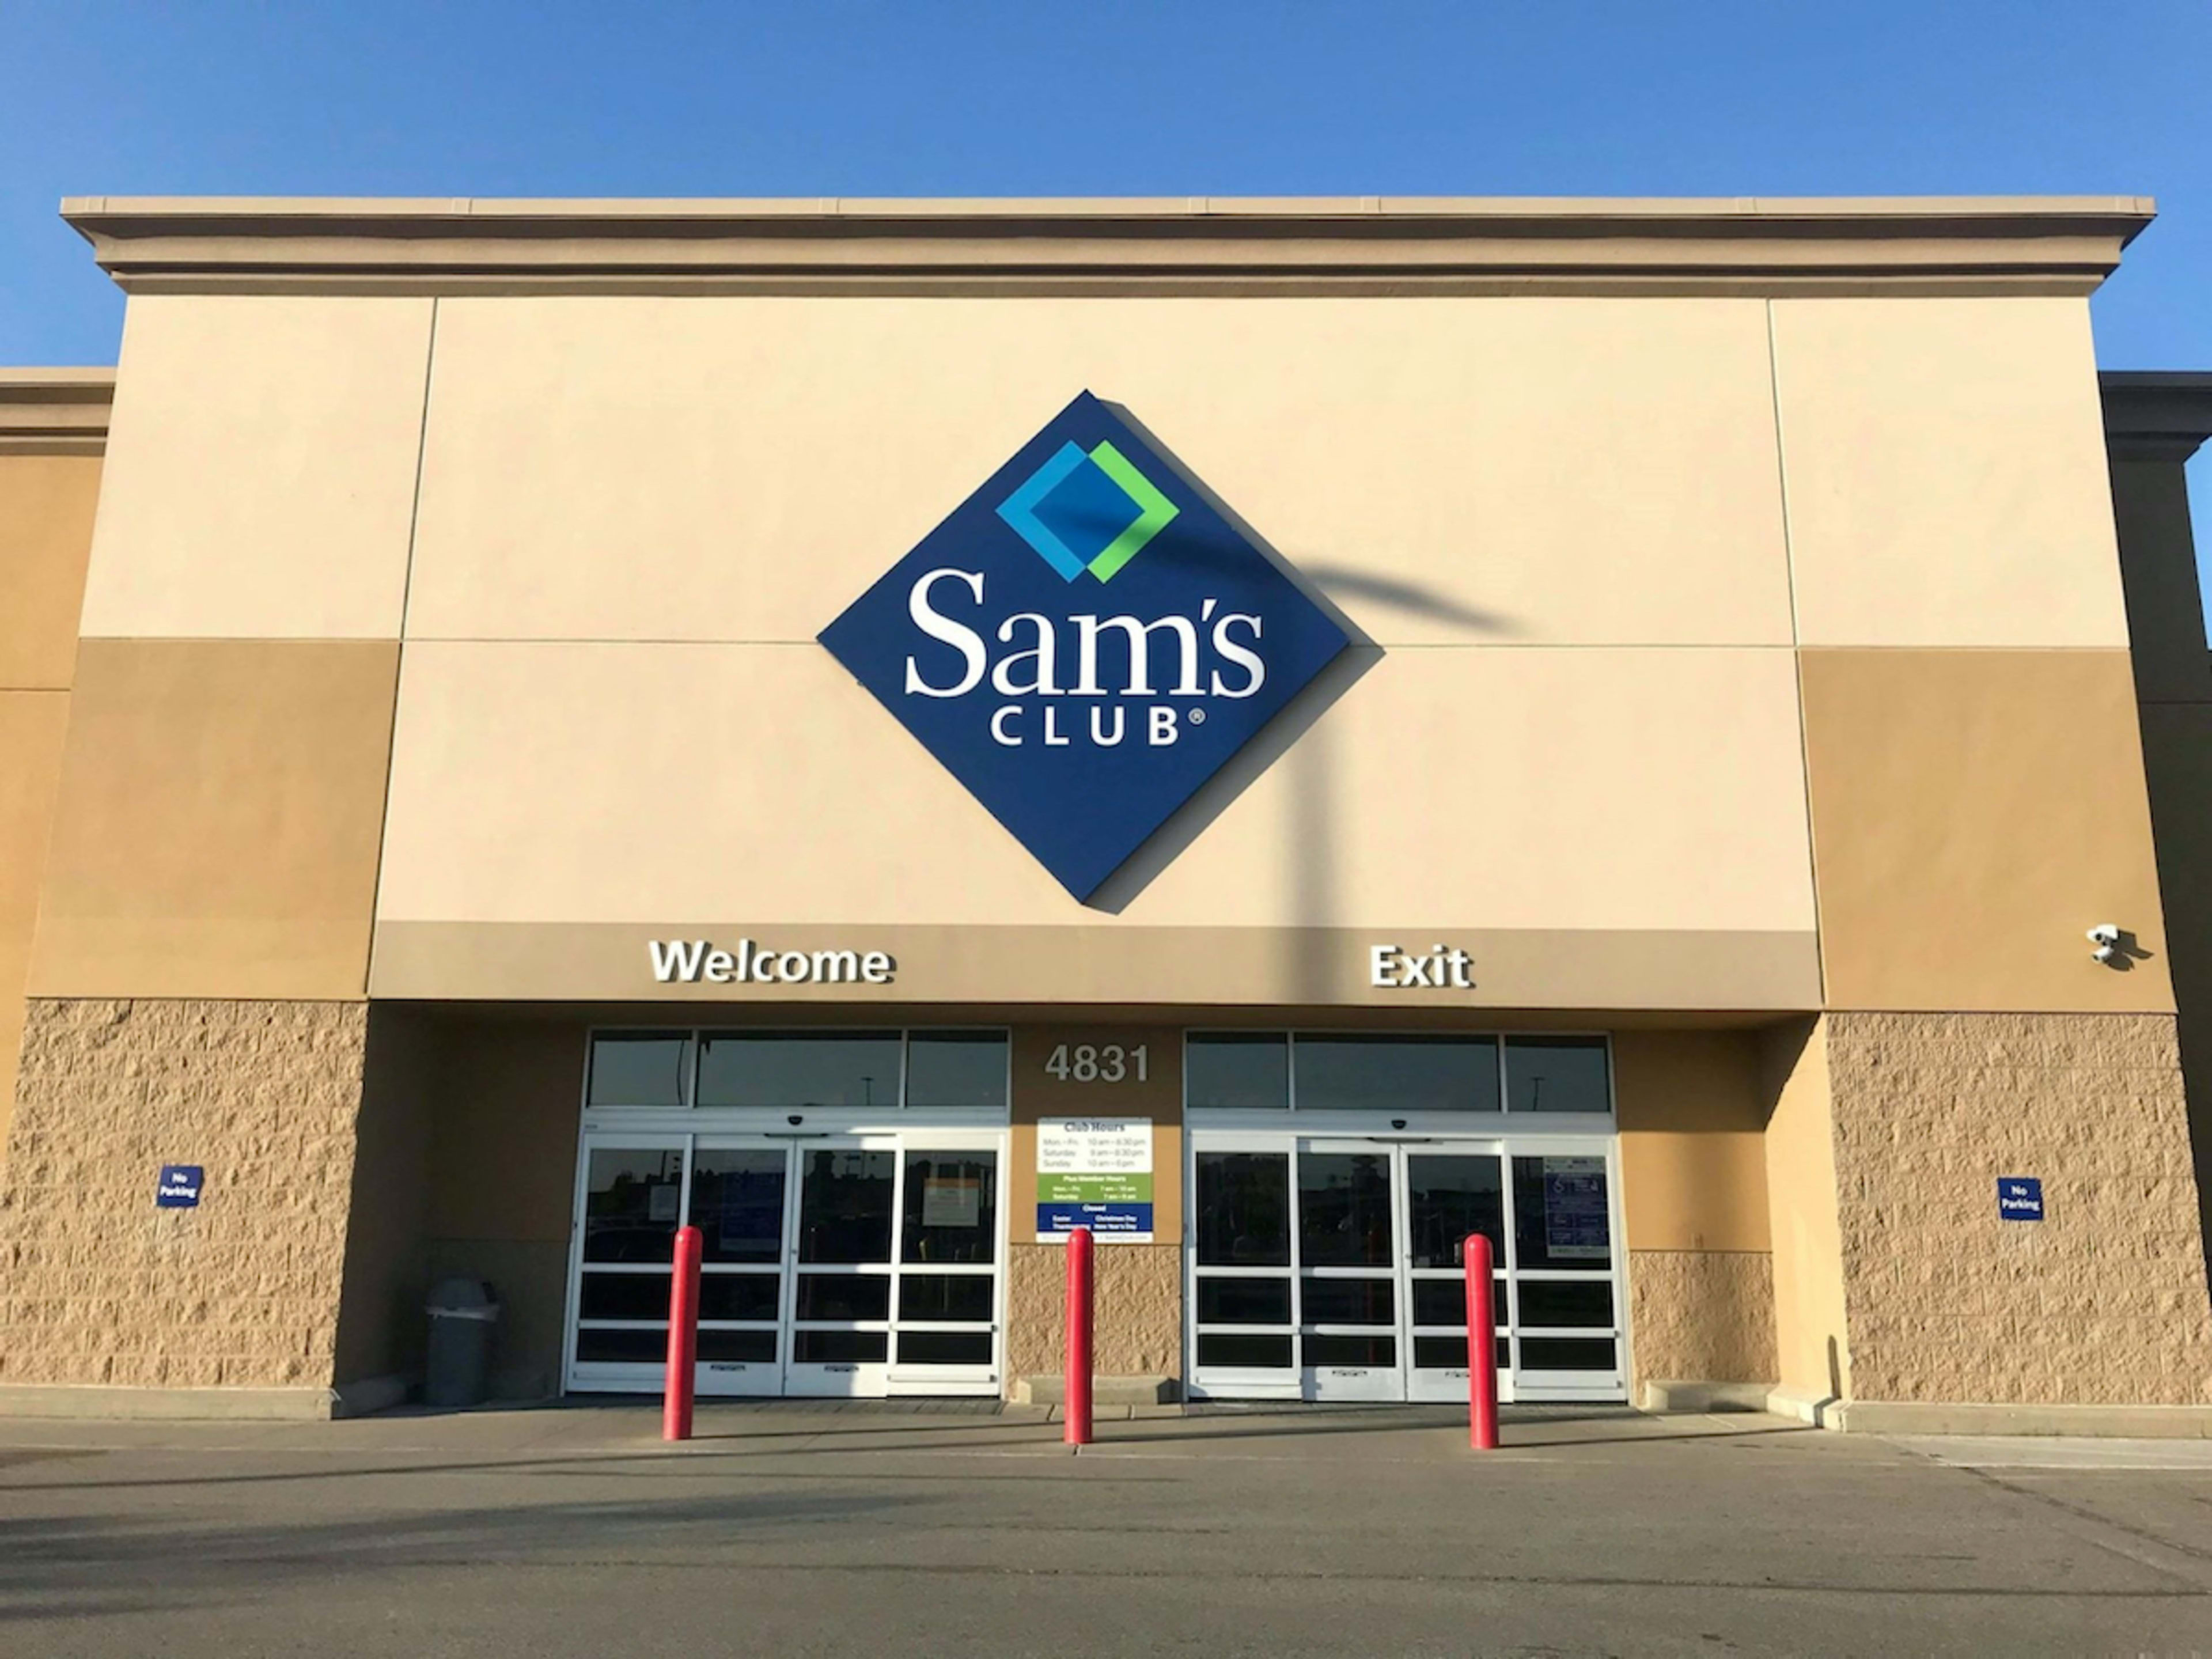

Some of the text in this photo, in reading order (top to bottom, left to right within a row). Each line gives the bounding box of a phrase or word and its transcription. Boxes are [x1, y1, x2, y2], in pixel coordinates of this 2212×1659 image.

[906, 568, 1266, 698] Sam's
[649, 938, 892, 982] Welcome
[1370, 944, 1471, 987] Exit
[1045, 1044, 1147, 1082] 4831
[1065, 1122, 1125, 1132] Club Hours
[1043, 1149, 1076, 1157] Saturday
[1043, 1159, 1071, 1168] Sunday
[172, 1173, 188, 1183] No
[160, 1185, 196, 1199] Parking
[2011, 1185, 2028, 1196] No
[1082, 1204, 1107, 1212] Closed
[2002, 1198, 2040, 1211] Parking
